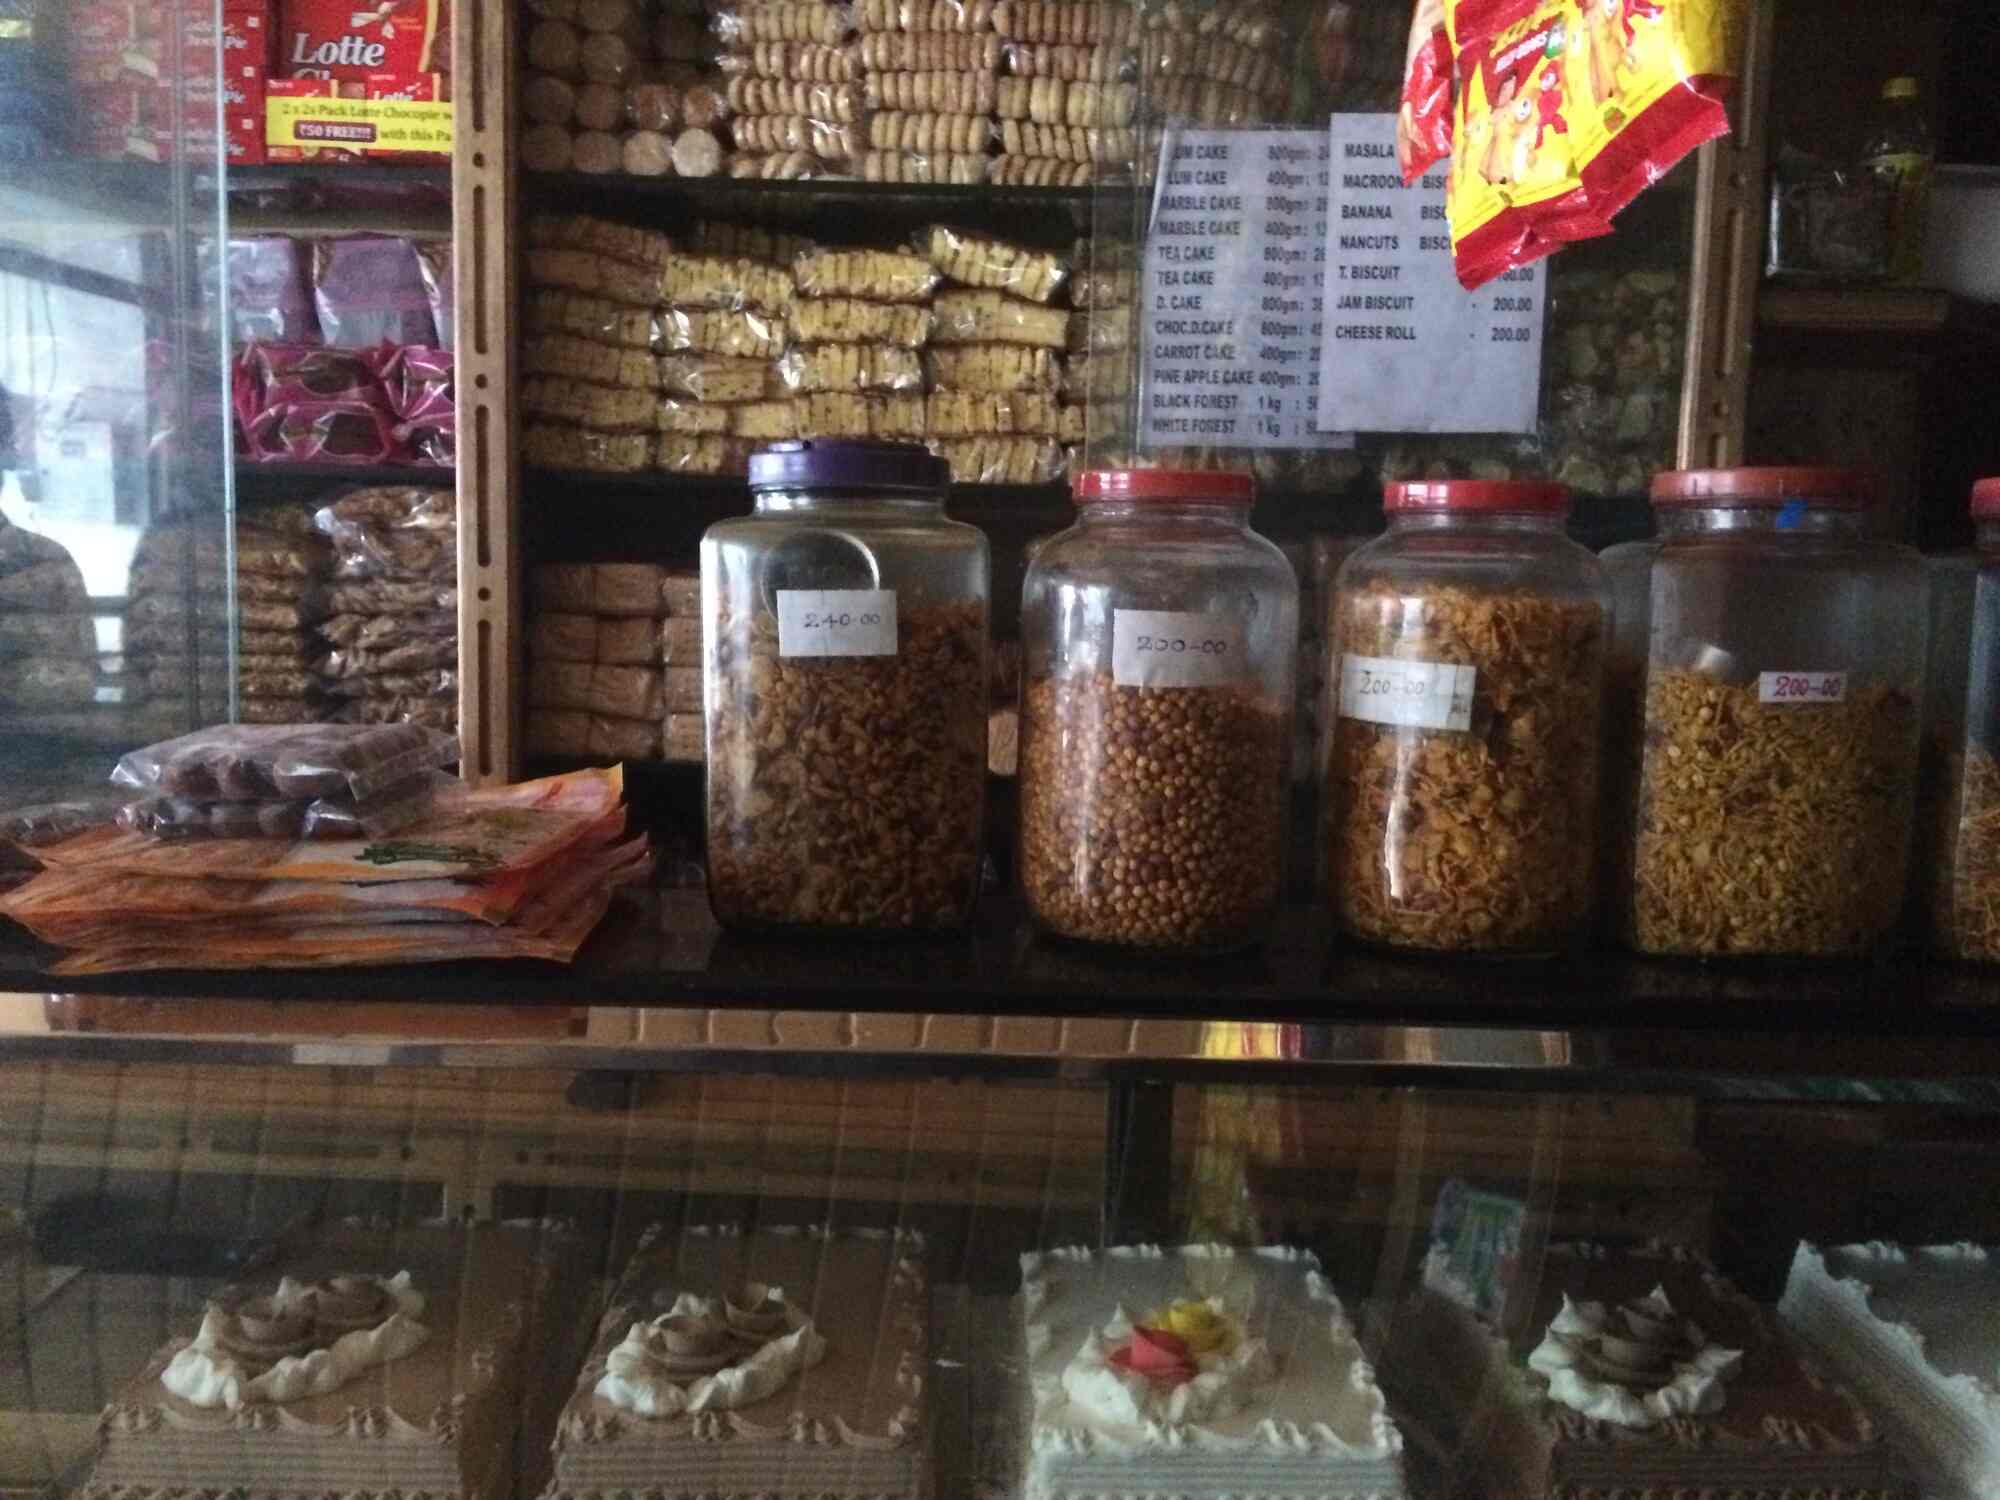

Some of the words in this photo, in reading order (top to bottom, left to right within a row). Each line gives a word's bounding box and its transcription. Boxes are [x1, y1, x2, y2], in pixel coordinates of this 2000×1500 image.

[292, 32, 385, 66] Lotte
[380, 128, 406, 140] with
[410, 129, 433, 141] this
[1196, 145, 1229, 160] CAKE
[1343, 143, 1395, 158] MASALA
[1195, 170, 1228, 185] CAKE
[1343, 174, 1411, 189] MACROON
[1159, 195, 1207, 210] MARBLE
[1210, 195, 1241, 210] CAKE
[1341, 205, 1392, 220] BANANA
[1158, 221, 1206, 236] MARBLE
[1209, 221, 1241, 236] CAKE
[1340, 235, 1399, 251] NANCUTS
[1157, 245, 1180, 260] TEA
[1183, 245, 1216, 260] CAKE
[1157, 271, 1180, 285] TEA
[1183, 271, 1215, 285] CAKE
[1350, 265, 1401, 281] BISCUIT
[1170, 295, 1202, 310] CAKE
[1336, 296, 1362, 311] JAM
[1364, 296, 1414, 311] BISCUIT
[1493, 297, 1533, 312] 200.00
[1335, 326, 1383, 340] CHEESE
[1385, 327, 1417, 341] ROLL
[1491, 327, 1531, 342] 200.00
[1154, 346, 1201, 360] CARROT
[1203, 346, 1236, 360] CAKE
[1153, 370, 1180, 385] PINE
[1183, 370, 1218, 385] APPLE
[1222, 371, 1254, 385] CAKE
[1152, 394, 1191, 409] BLACK
[1194, 395, 1239, 409] FOREST
[1267, 395, 1282, 413] kg
[1152, 419, 1188, 433] WHITE
[1191, 419, 1236, 433] FOREST
[1266, 420, 1281, 437] kg
